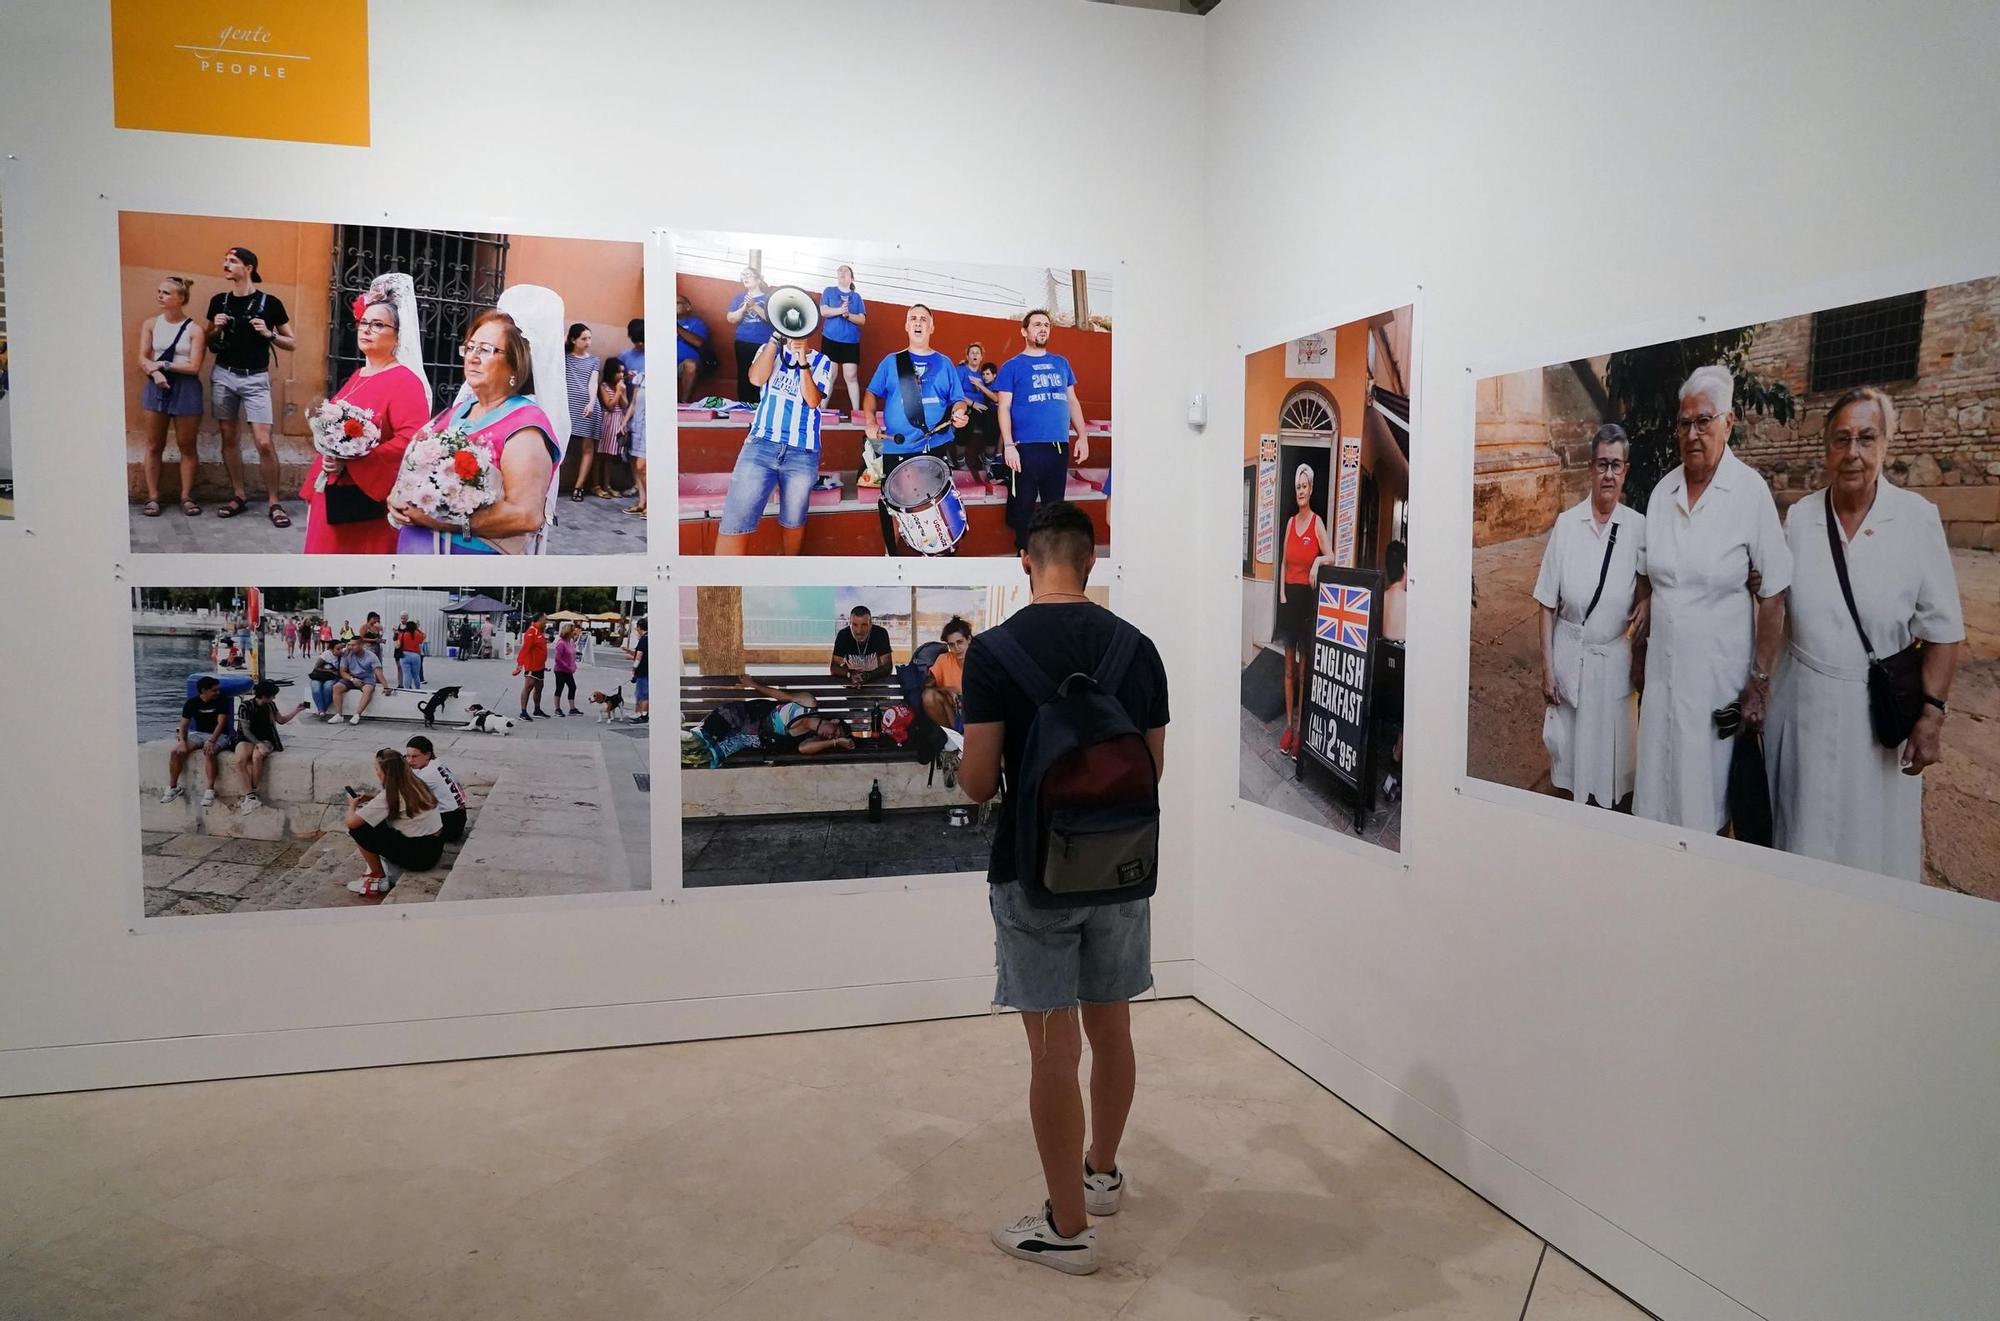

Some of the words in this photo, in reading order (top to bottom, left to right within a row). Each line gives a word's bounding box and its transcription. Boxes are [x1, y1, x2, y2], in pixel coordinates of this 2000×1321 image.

[194, 25, 272, 58] gente
[201, 61, 286, 78] PEOPLE
[1313, 642, 1365, 690] ENGLISH
[1311, 674, 1363, 726] BREAKFAST
